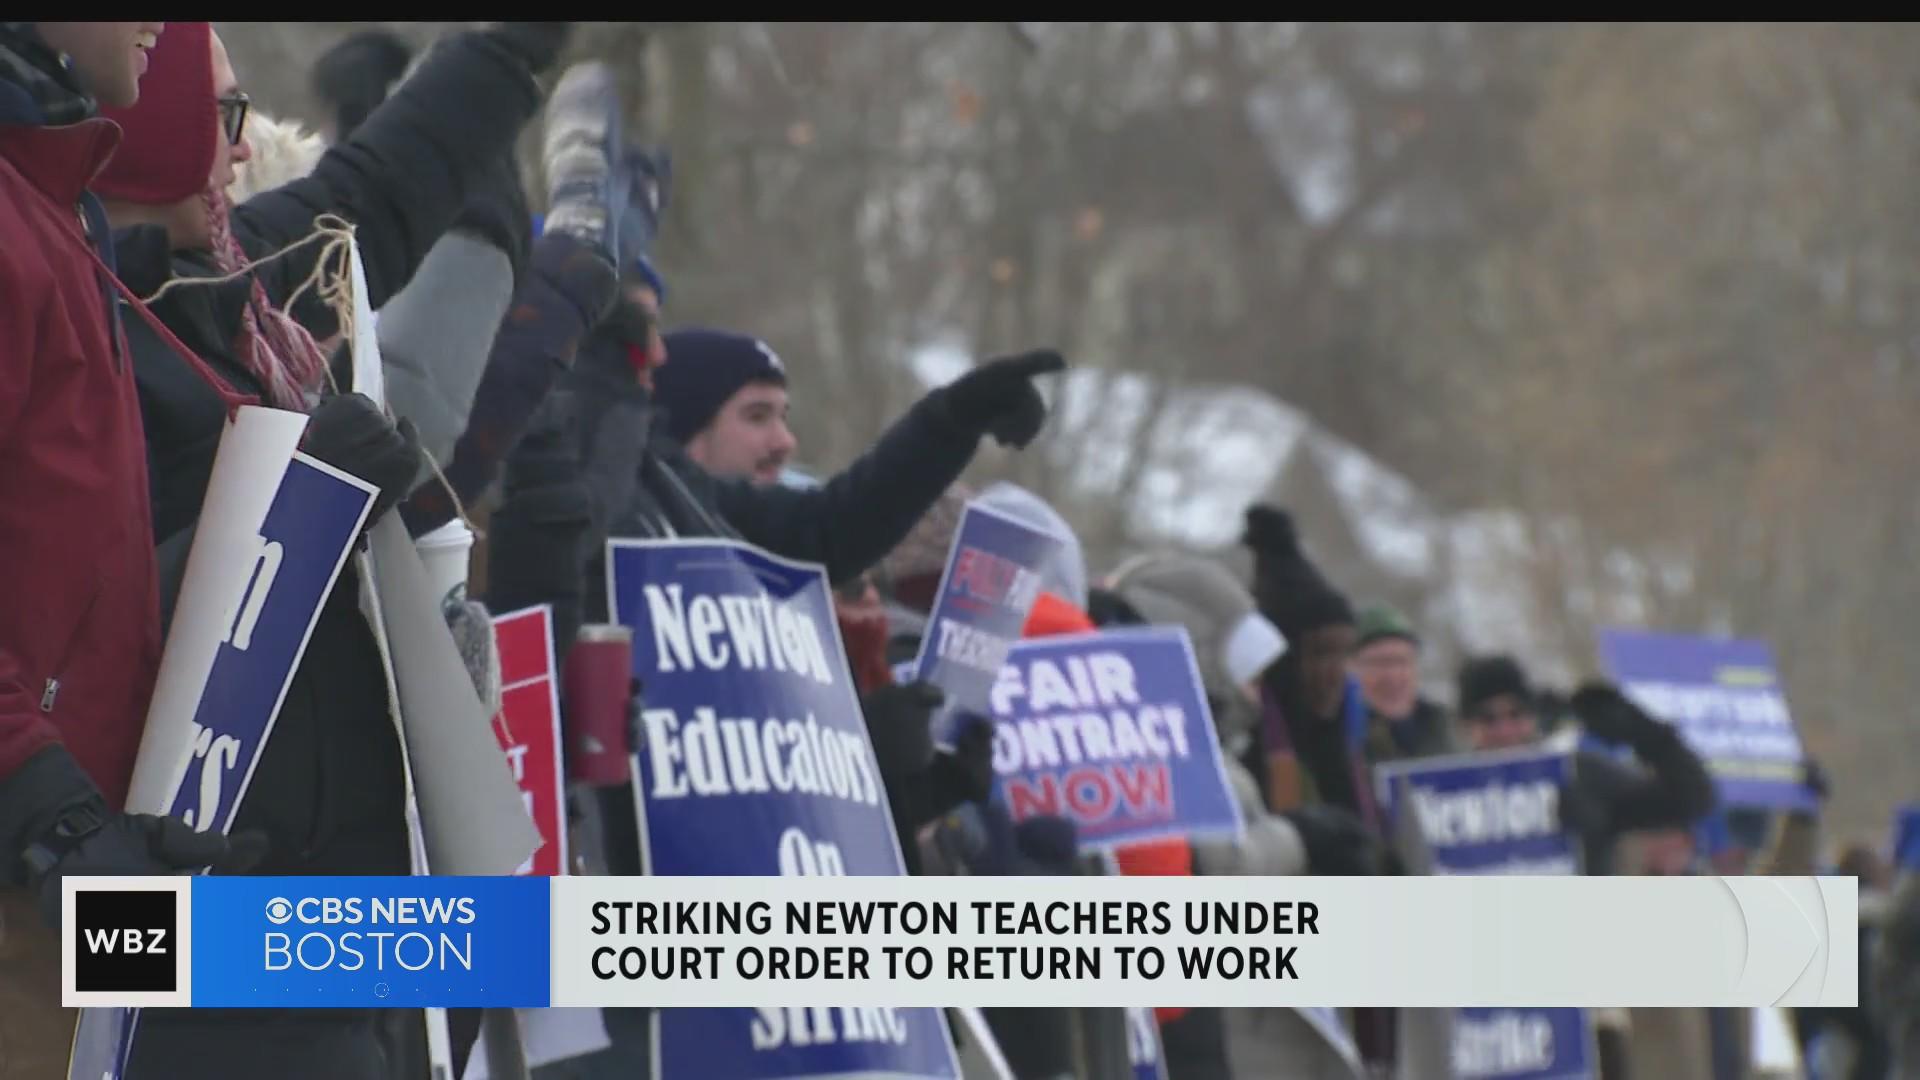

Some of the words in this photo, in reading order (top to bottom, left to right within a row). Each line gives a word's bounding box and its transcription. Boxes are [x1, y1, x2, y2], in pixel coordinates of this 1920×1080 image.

[642, 583, 833, 686] Newton
[991, 652, 1141, 716] FAIR
[991, 704, 1190, 776] ONTRACT
[1004, 762, 1176, 824] NOW
